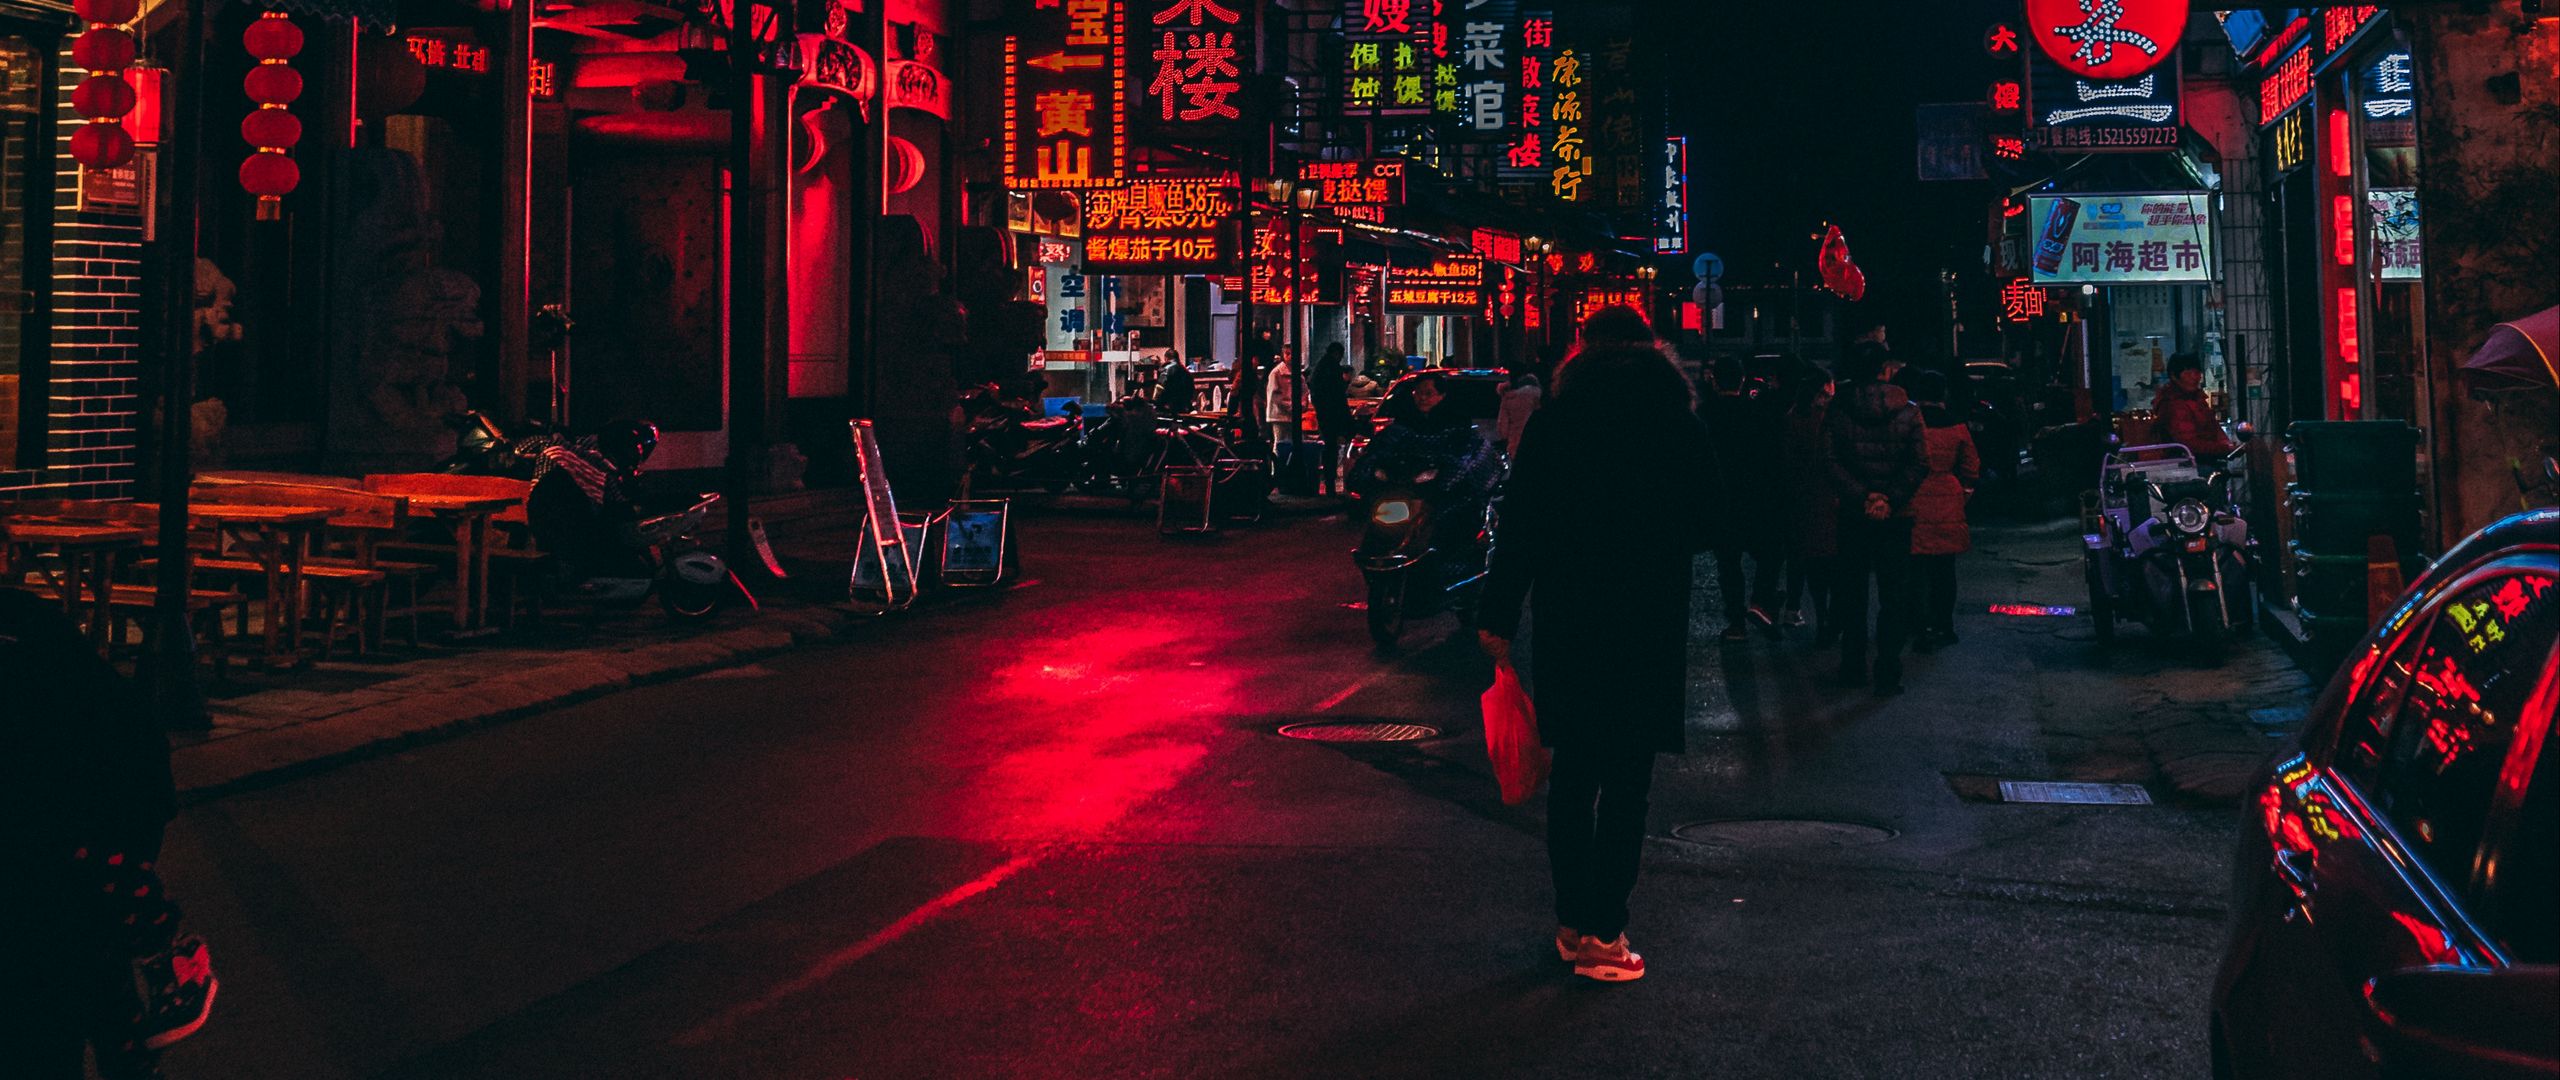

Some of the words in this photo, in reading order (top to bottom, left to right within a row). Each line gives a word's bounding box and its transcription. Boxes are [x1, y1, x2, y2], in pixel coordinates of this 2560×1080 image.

[1034, 89, 1095, 181] 黄山
[1086, 236, 1217, 261] 酱爆茄子10元
[2071, 240, 2202, 273] 阿海超市
